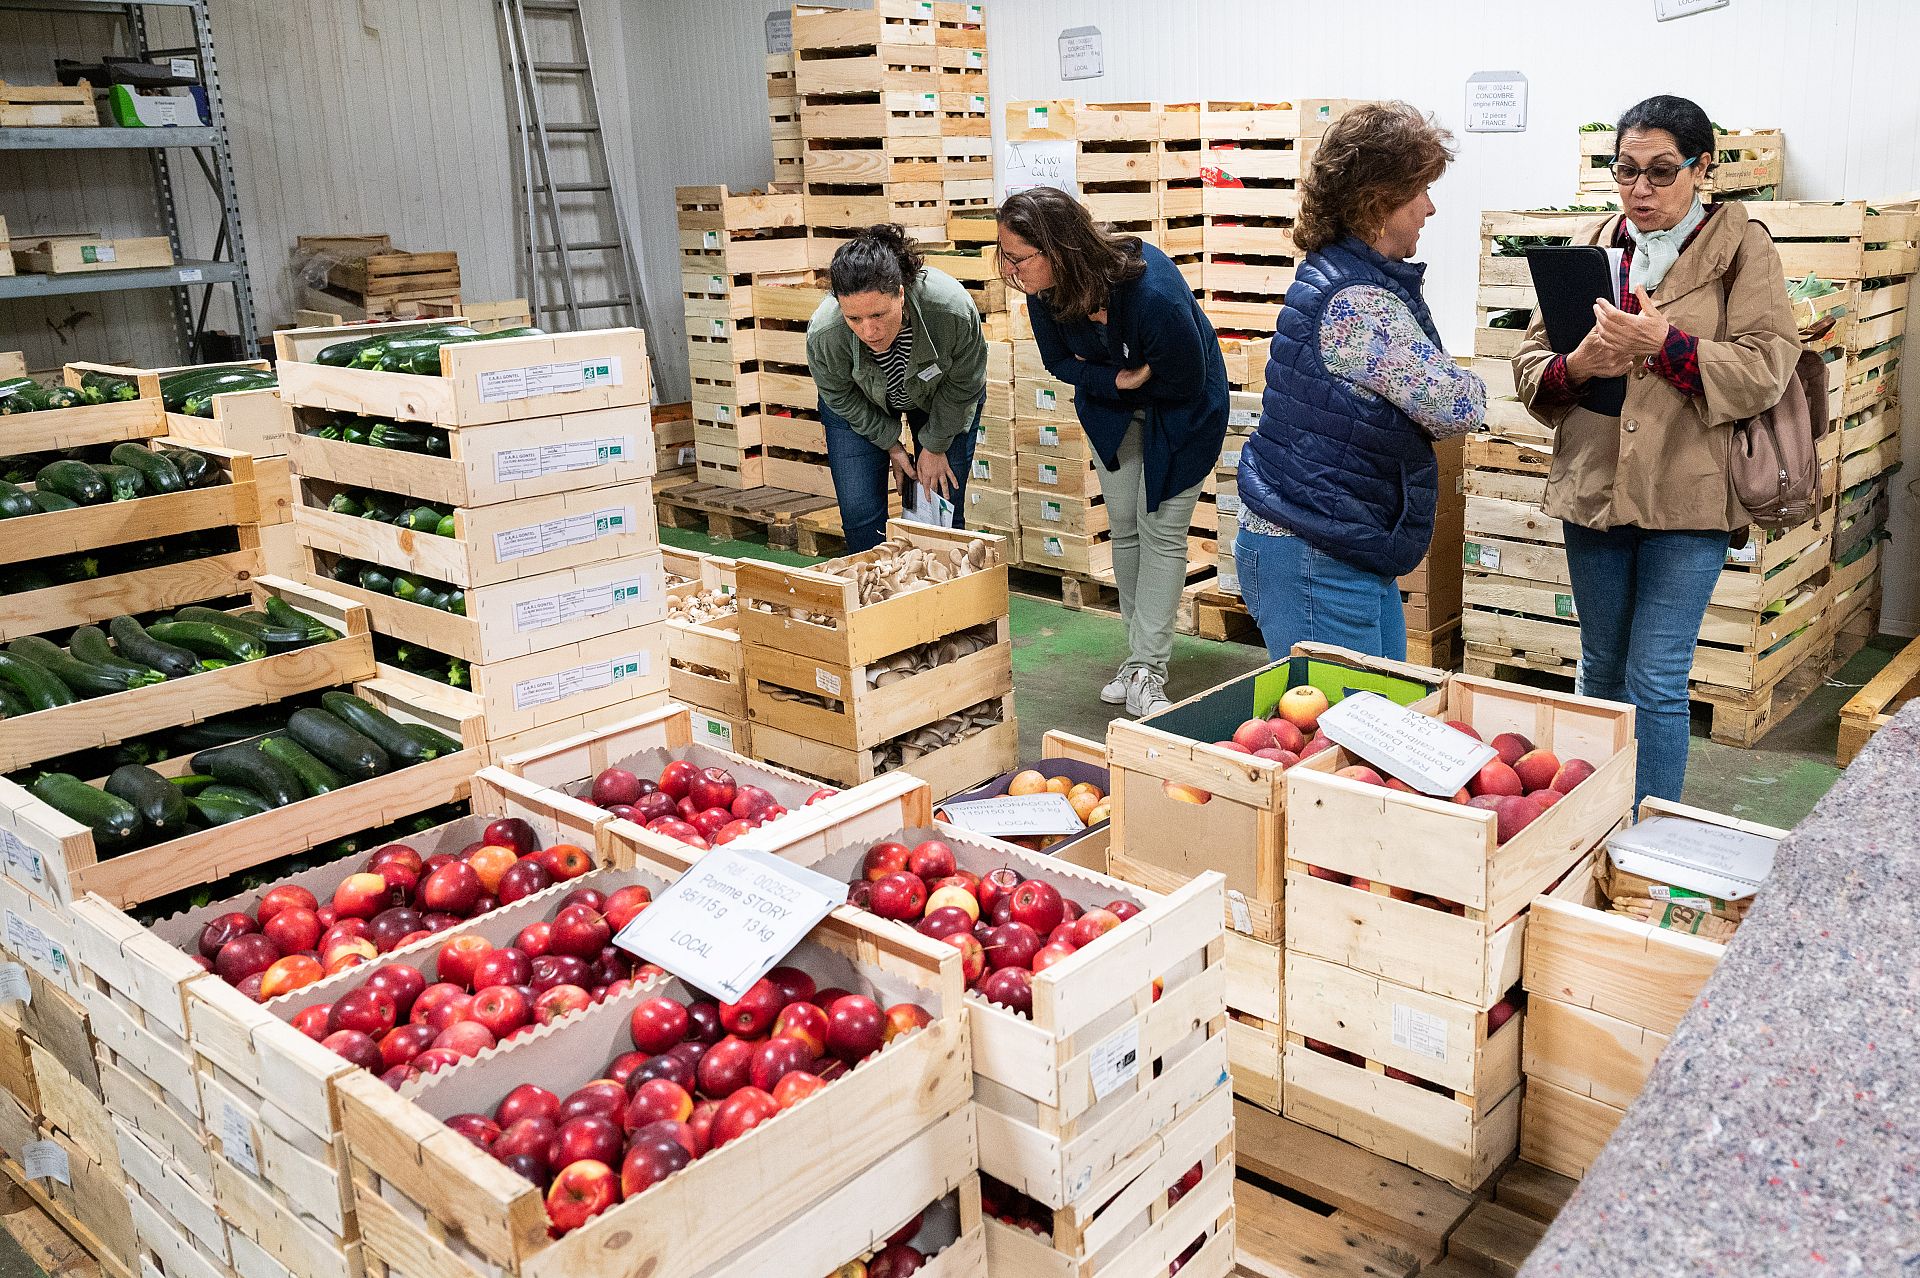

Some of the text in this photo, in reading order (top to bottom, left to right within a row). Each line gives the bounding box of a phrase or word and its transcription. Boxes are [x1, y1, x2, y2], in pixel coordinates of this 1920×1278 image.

[1034, 153, 1061, 165] Kiwi
[1031, 166, 1046, 177] Cal
[1401, 717, 1431, 736] 13 kg
[1407, 711, 1446, 734] LOCAL
[1346, 711, 1451, 772] Pomme Dalisweet
[1396, 728, 1438, 748] calibre
[1440, 750, 1466, 766] gros
[950, 803, 996, 812] Pomme
[997, 799, 1062, 808] JONAGOLD
[1696, 826, 1745, 842] LOCAL
[699, 873, 793, 921] Pomme STORY
[753, 874, 801, 903] 002522
[679, 887, 776, 943] 95/115 g 13 kg
[669, 930, 714, 960] LOCAL
